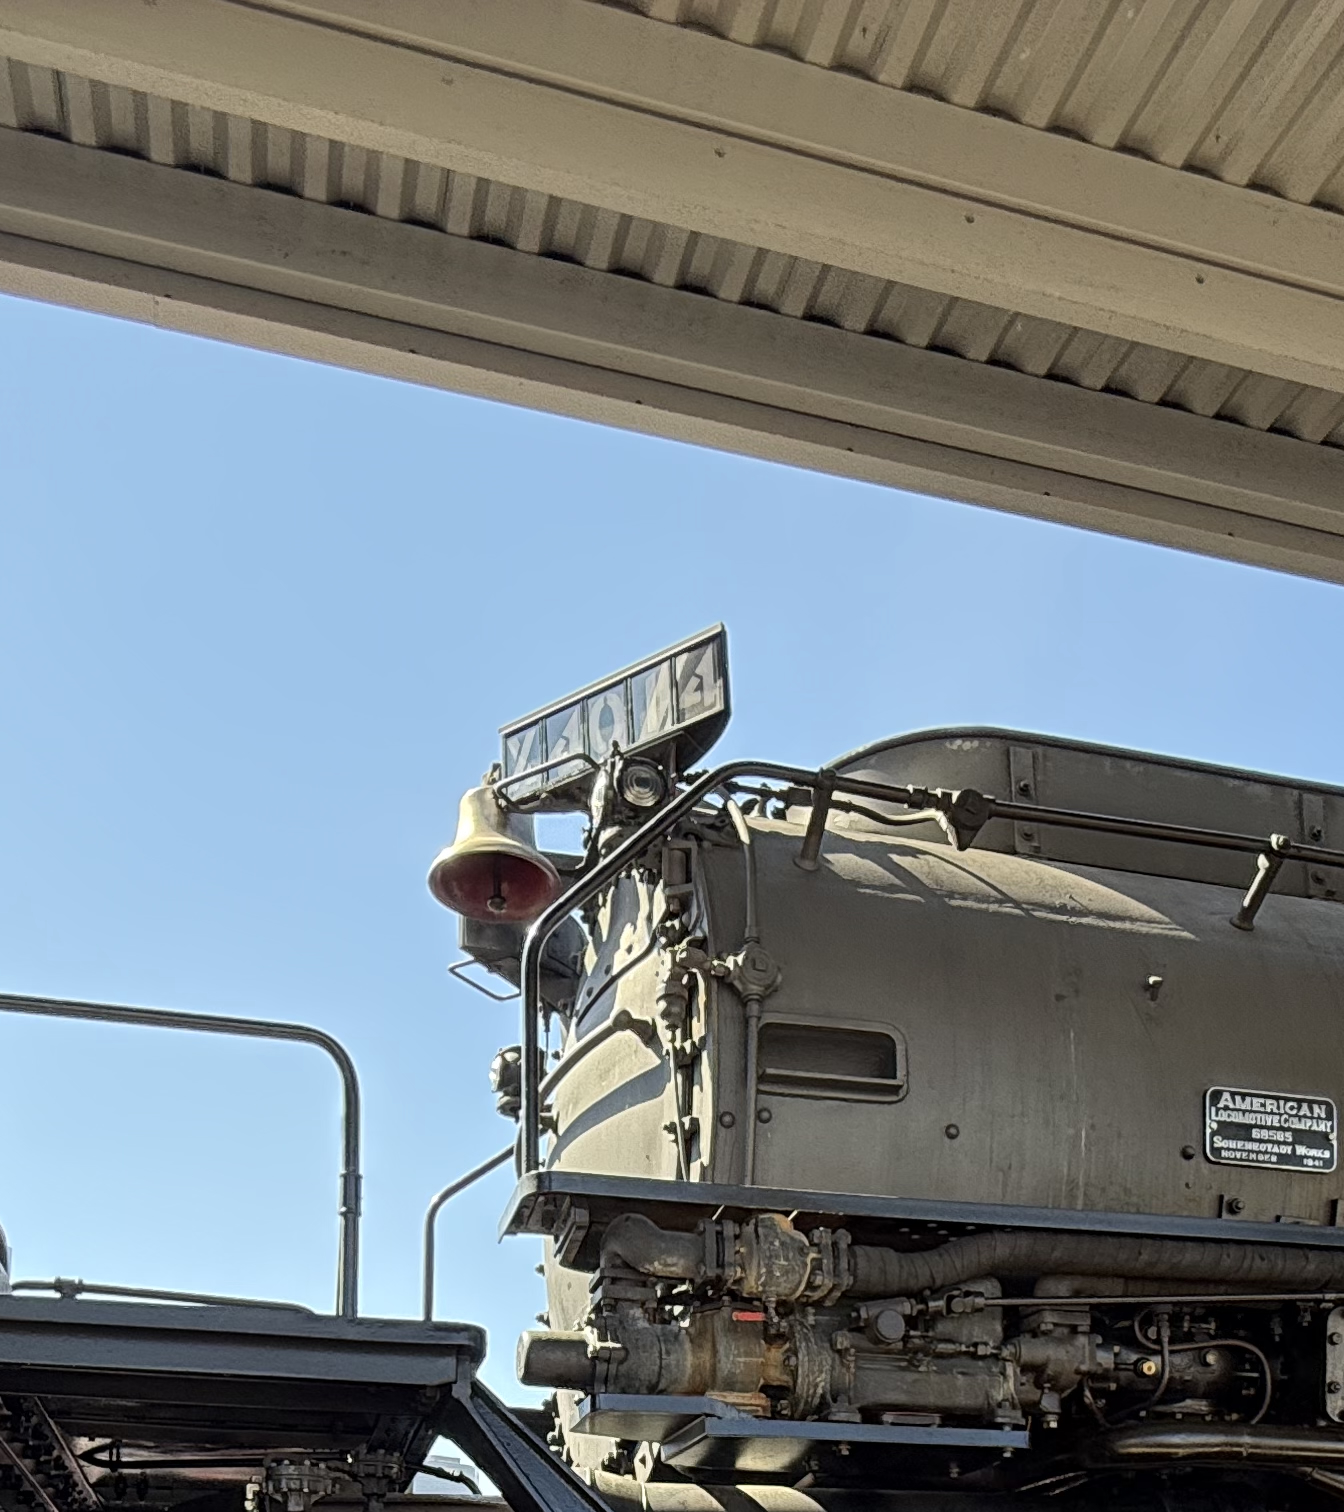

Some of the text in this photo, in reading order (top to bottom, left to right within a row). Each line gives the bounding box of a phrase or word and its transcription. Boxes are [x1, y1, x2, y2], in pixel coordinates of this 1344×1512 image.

[1217, 1092, 1327, 1118] AMERICAN
[1211, 1106, 1332, 1132] LOCOMOTIVE COMPANY
[1213, 1136, 1331, 1158] SCHENECTADY WORKS
[1221, 1150, 1278, 1163] NOVEMBER
